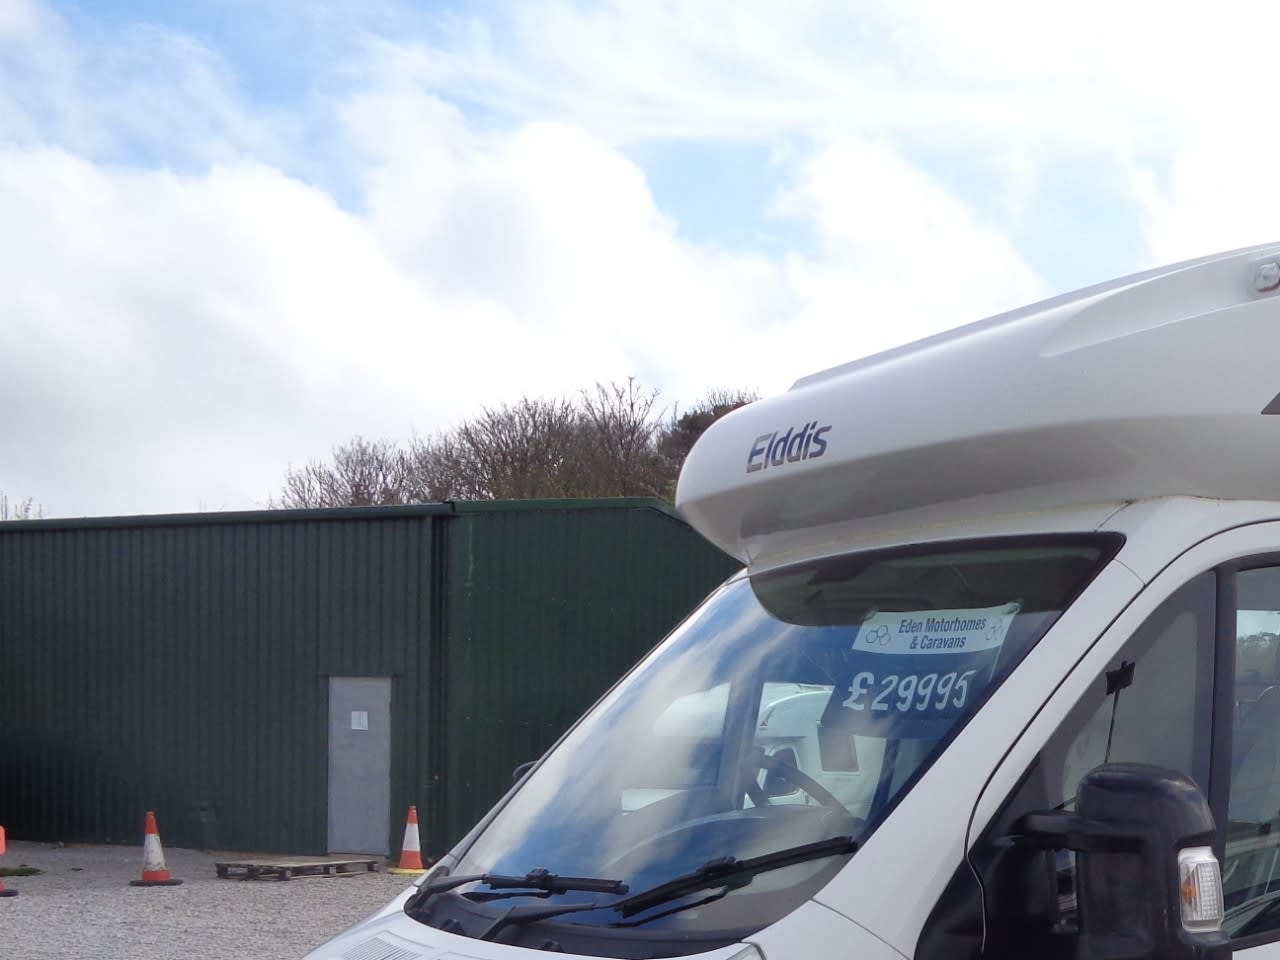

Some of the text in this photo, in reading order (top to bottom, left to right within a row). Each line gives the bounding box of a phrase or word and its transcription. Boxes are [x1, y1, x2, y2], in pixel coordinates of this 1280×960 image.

[746, 421, 832, 473] Elddis
[899, 618, 987, 633] Eden Motorhomes
[910, 635, 966, 649] & Caravans
[843, 669, 976, 712] £29995
